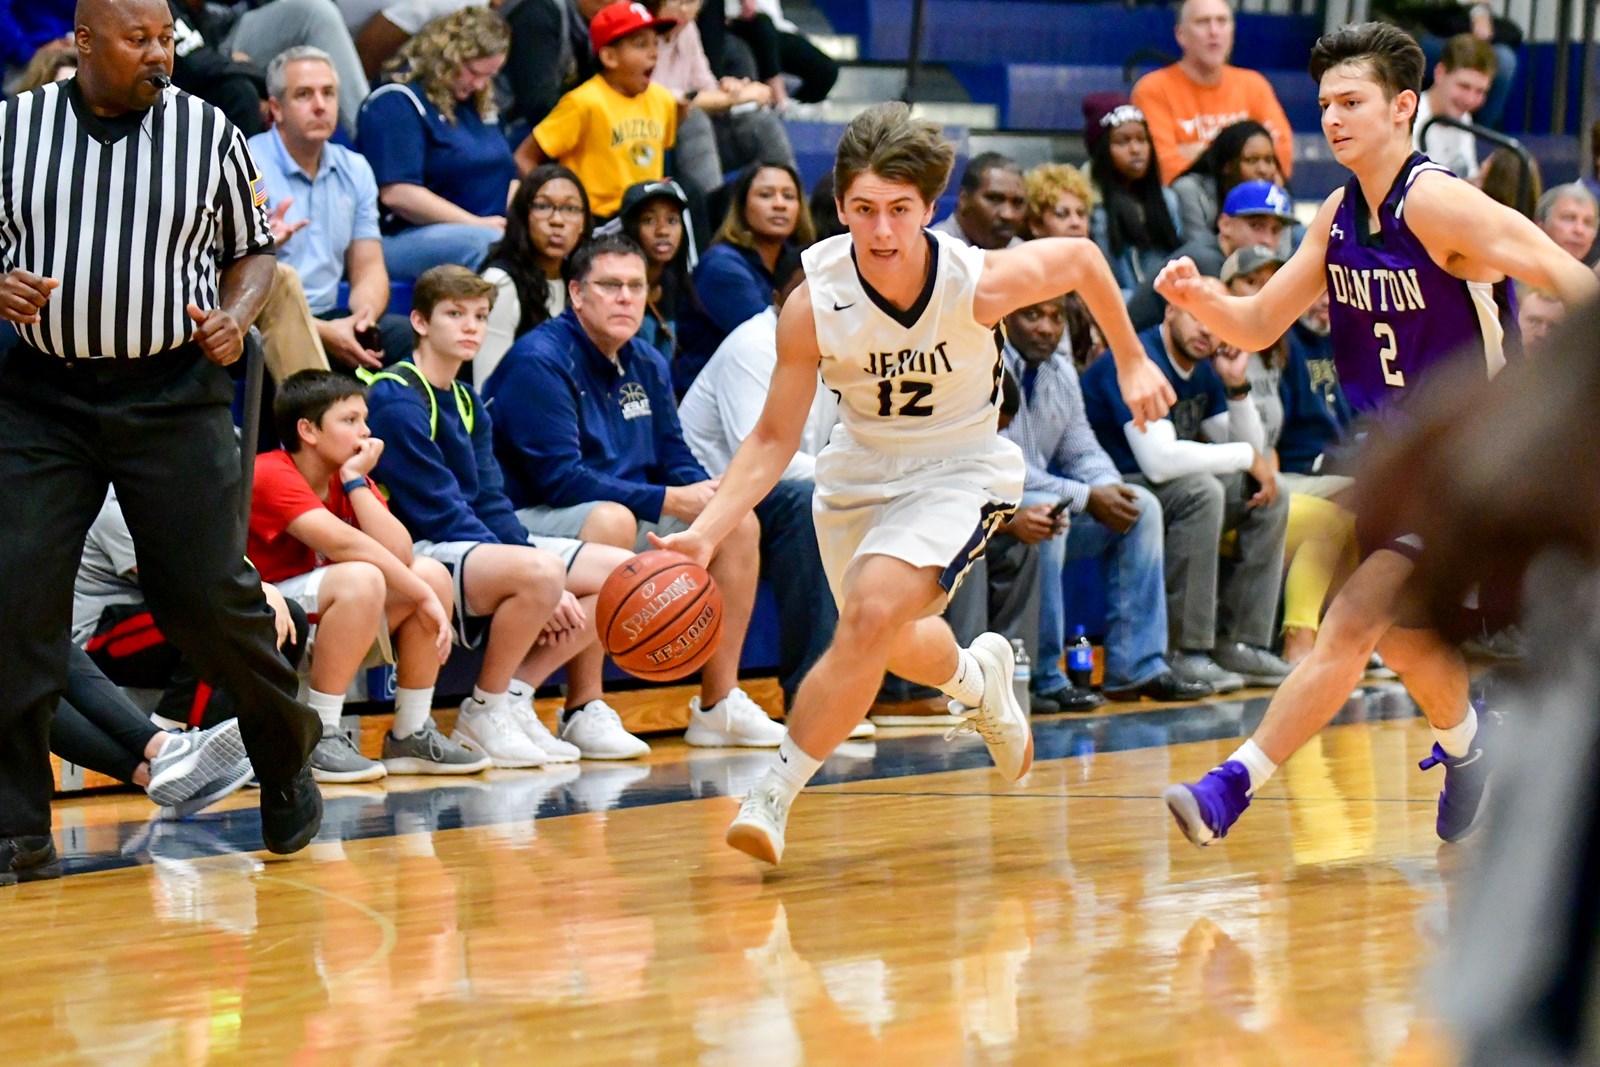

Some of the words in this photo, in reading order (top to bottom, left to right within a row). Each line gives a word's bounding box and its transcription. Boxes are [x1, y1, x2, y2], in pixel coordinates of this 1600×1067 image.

[1373, 322, 1405, 387] 2
[877, 379, 934, 417] 12
[620, 572, 699, 641] SPALDING
